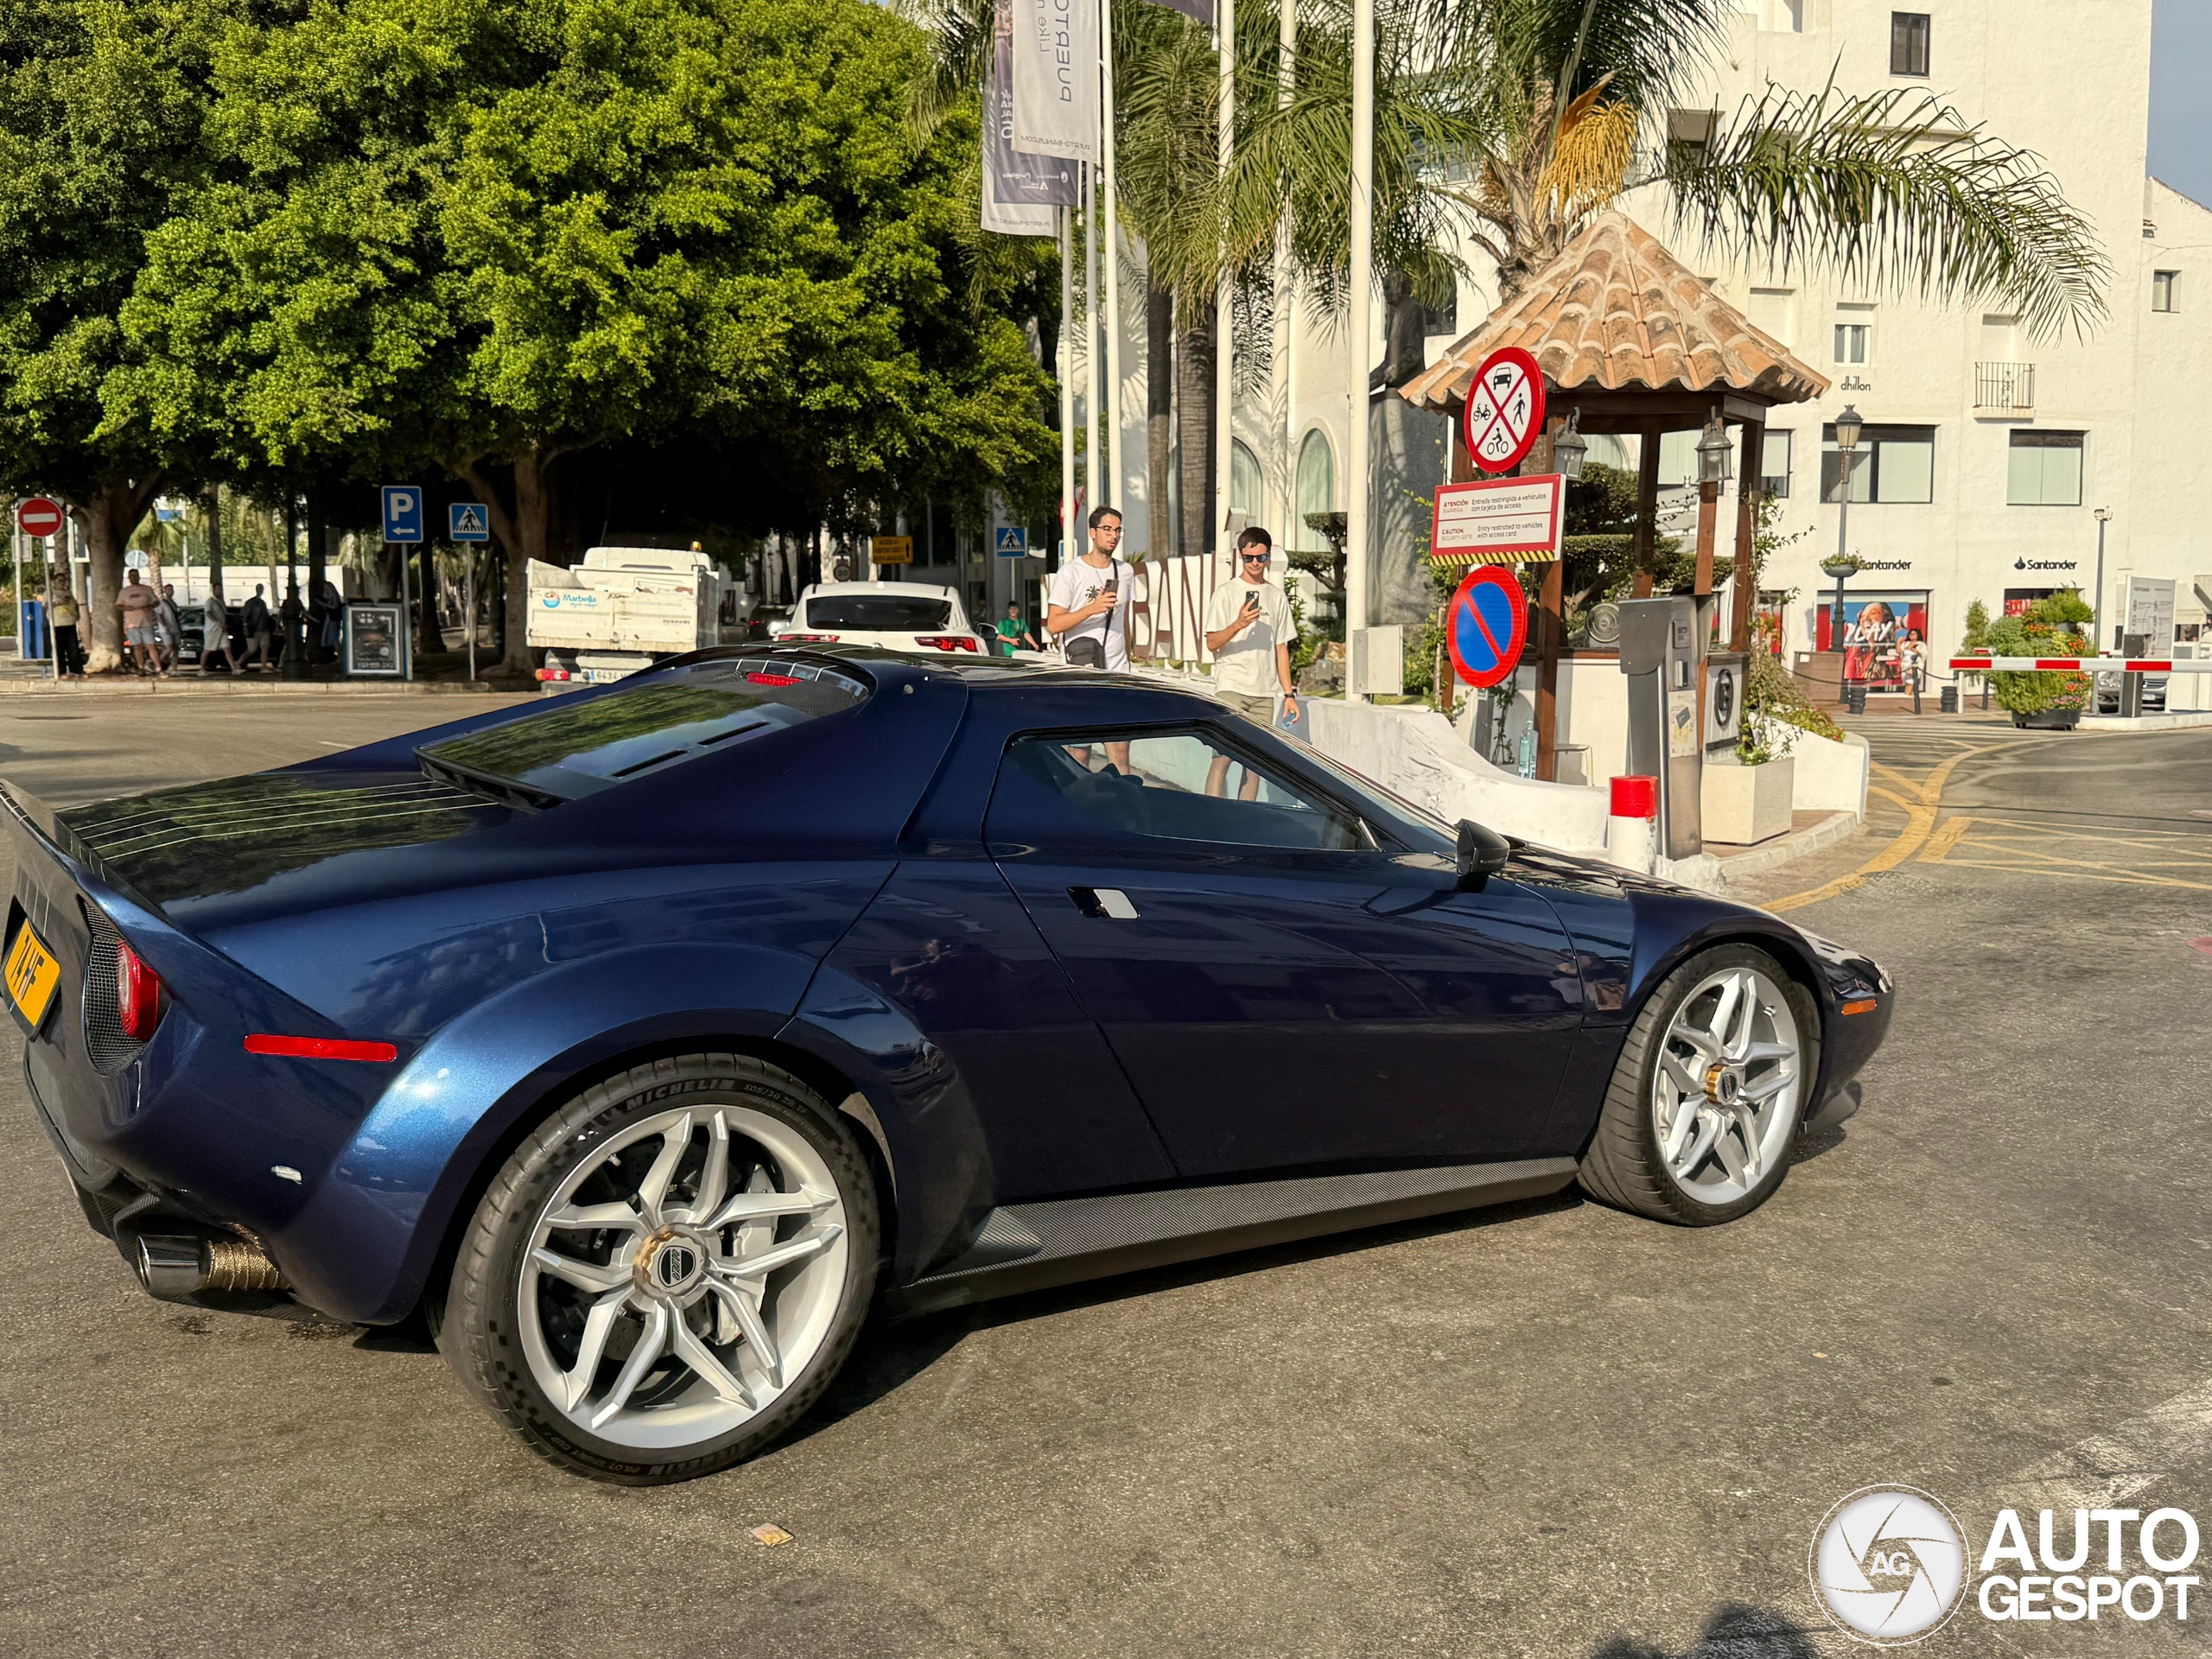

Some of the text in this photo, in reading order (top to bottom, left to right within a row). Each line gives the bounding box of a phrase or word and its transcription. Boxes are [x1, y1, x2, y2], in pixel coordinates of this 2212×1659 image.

[1840, 375, 1871, 391] dhillon
[390, 493, 414, 522] P
[1443, 499, 1469, 508] ATENCIÓN
[2027, 559, 2077, 570] Santander
[563, 594, 597, 603] Marbella
[626, 1078, 734, 1111] MICHELIN
[608, 1463, 640, 1474] PILOT
